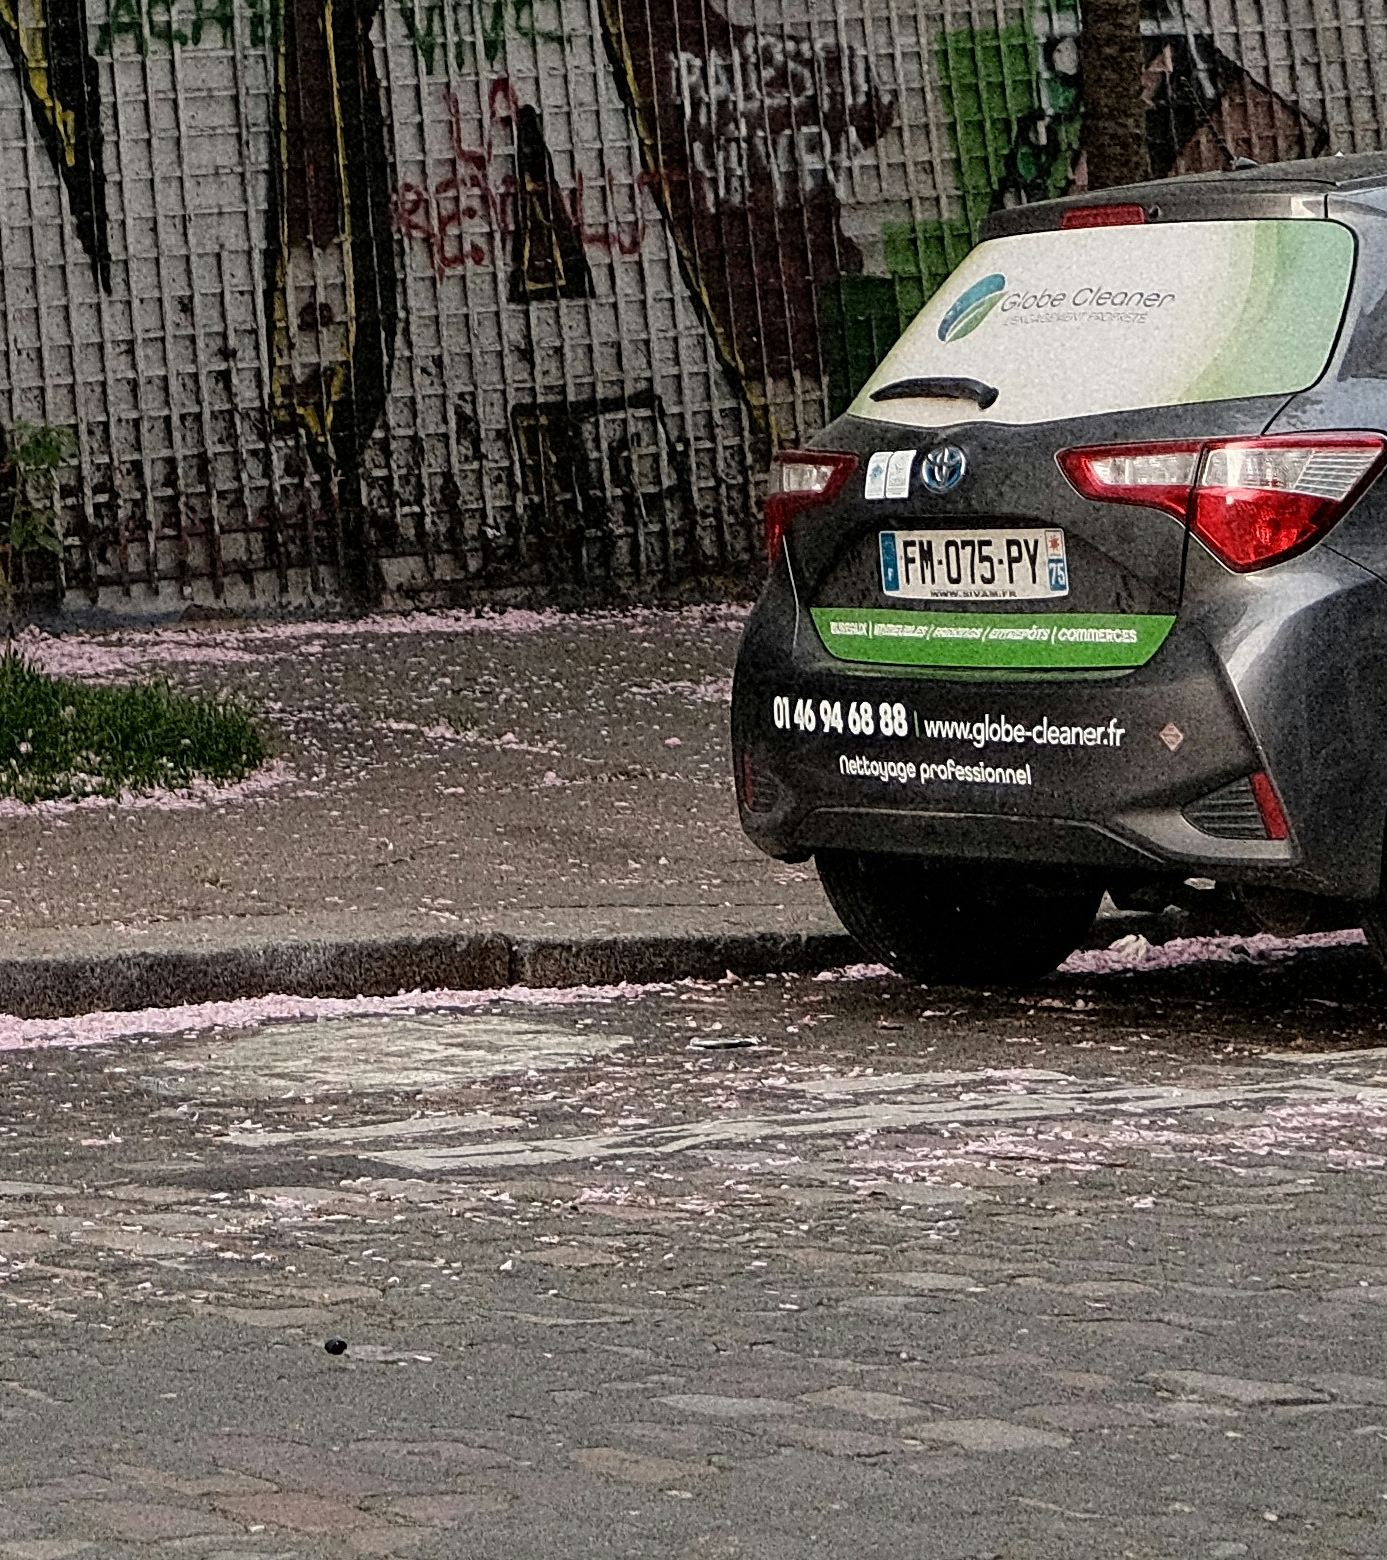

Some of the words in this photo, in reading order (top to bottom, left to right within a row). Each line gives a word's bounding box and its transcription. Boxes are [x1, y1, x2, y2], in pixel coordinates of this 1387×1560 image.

[1001, 287, 1067, 312] Globe
[1072, 286, 1176, 309] Cleaner
[901, 538, 1039, 585] FM-075-PY
[1048, 563, 1067, 585] 75
[1057, 627, 1138, 643] COMMERCES
[773, 695, 791, 730] 01
[794, 698, 816, 732] 46
[819, 699, 844, 734] 94
[848, 701, 875, 735] 68
[879, 702, 908, 737] 88
[924, 713, 1125, 748] www.globe-cleaner.fr
[839, 754, 917, 783] Nettoyage
[920, 759, 1032, 785] professionnel
